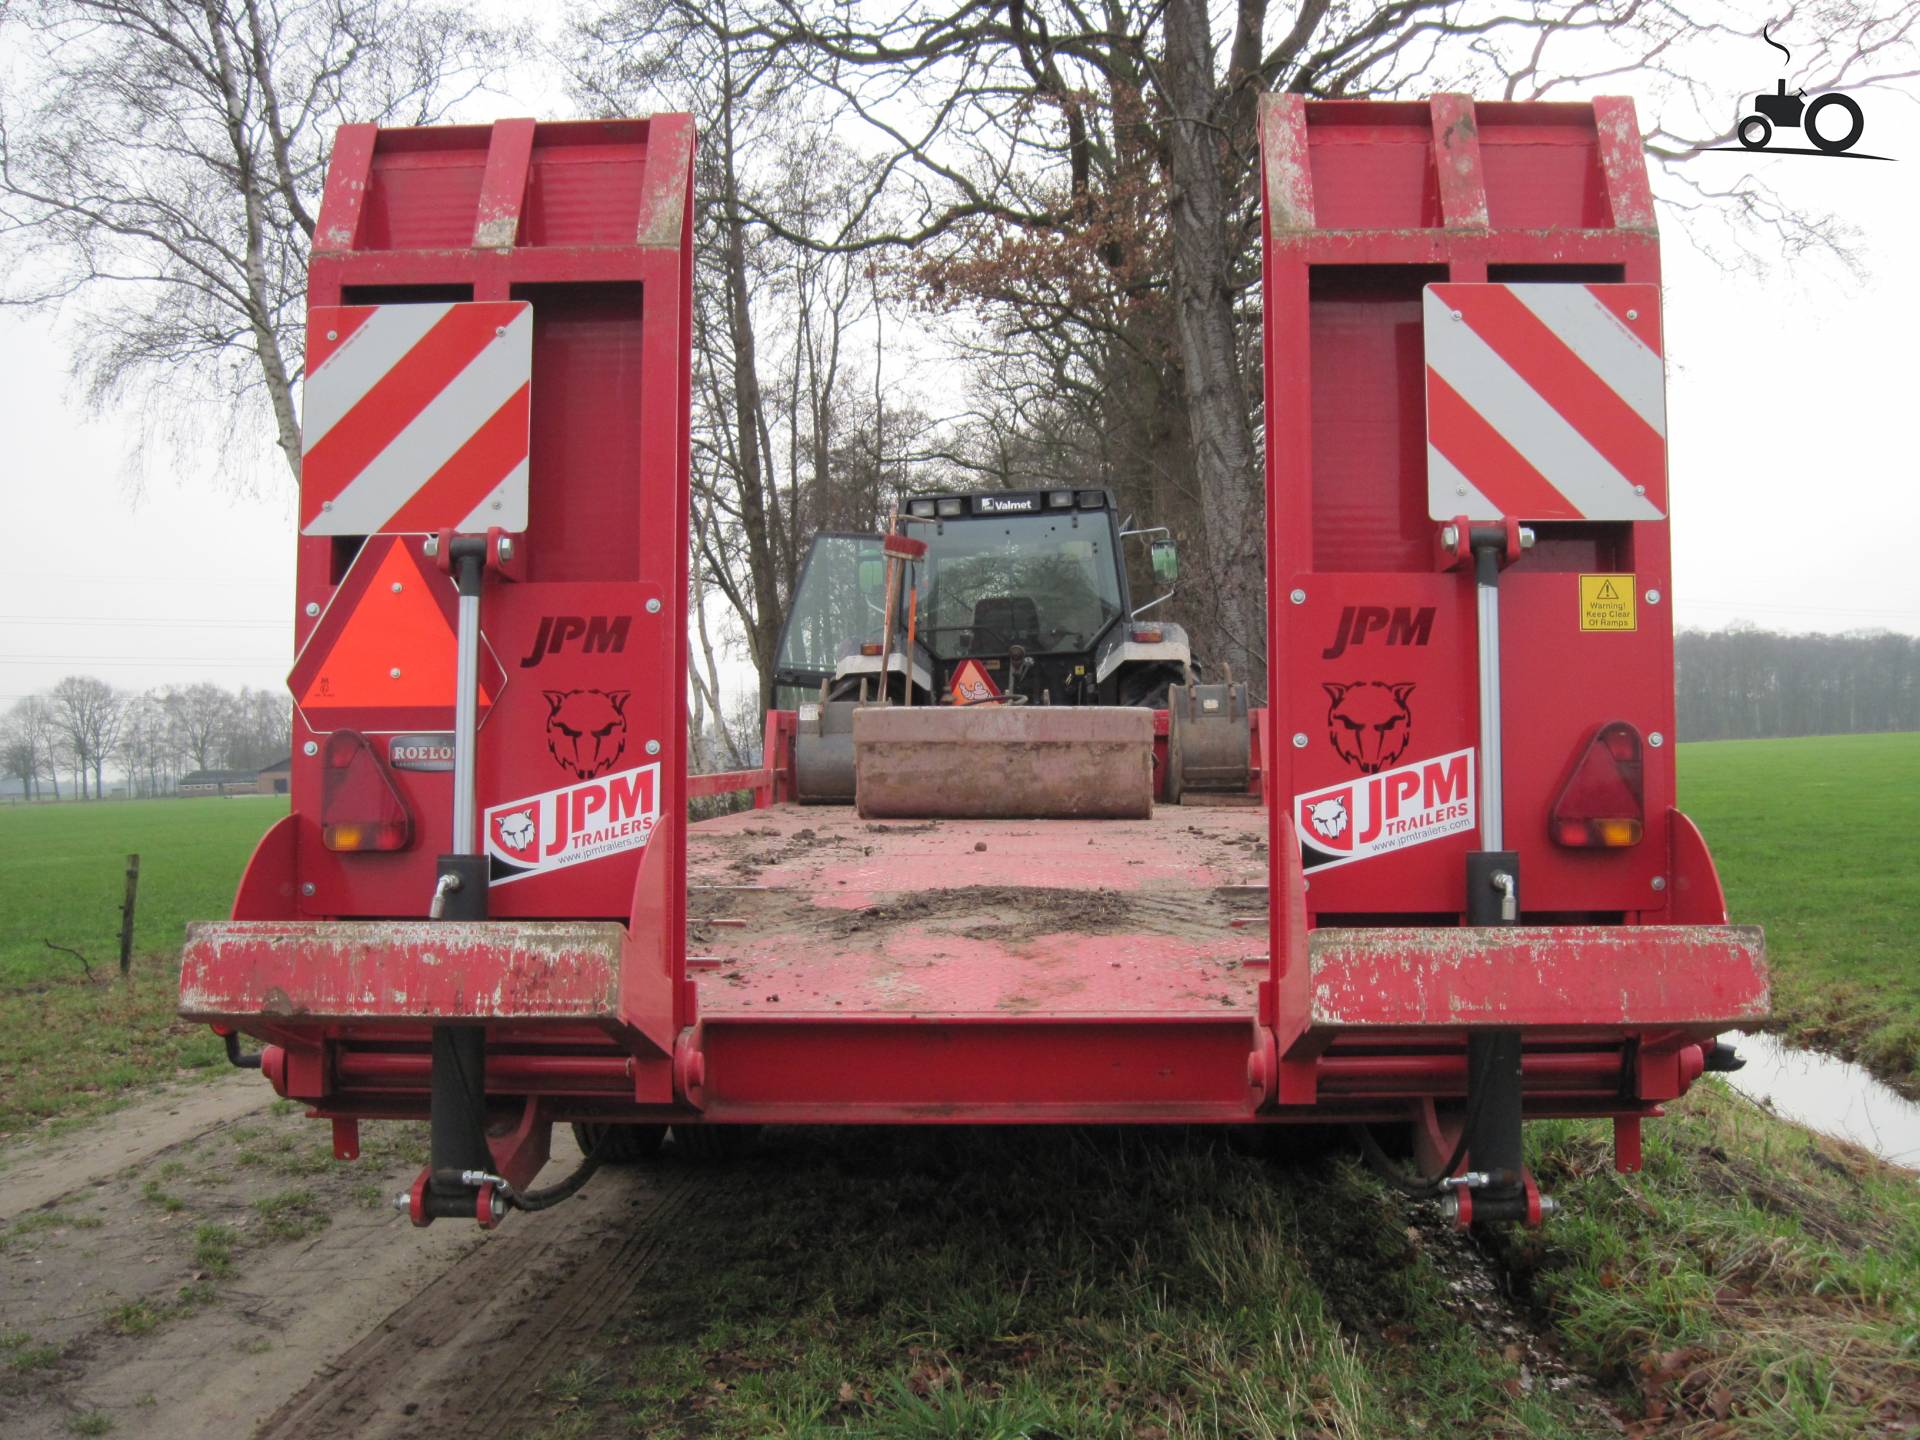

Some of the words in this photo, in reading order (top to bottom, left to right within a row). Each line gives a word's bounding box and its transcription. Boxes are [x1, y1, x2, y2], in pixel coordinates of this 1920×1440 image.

[995, 500, 1032, 510] Valmet
[1590, 602, 1626, 611] Warning!
[1600, 619, 1628, 627] Ramps
[520, 616, 633, 668] JPM
[1322, 606, 1438, 660] JPM
[394, 745, 455, 760] ROELO
[546, 769, 654, 857] JPM
[1359, 754, 1468, 844] JPM
[572, 817, 653, 849] TRAILERS
[1371, 818, 1471, 851] www.jpmtrailers.com
[1386, 803, 1468, 836] TRAILERS
